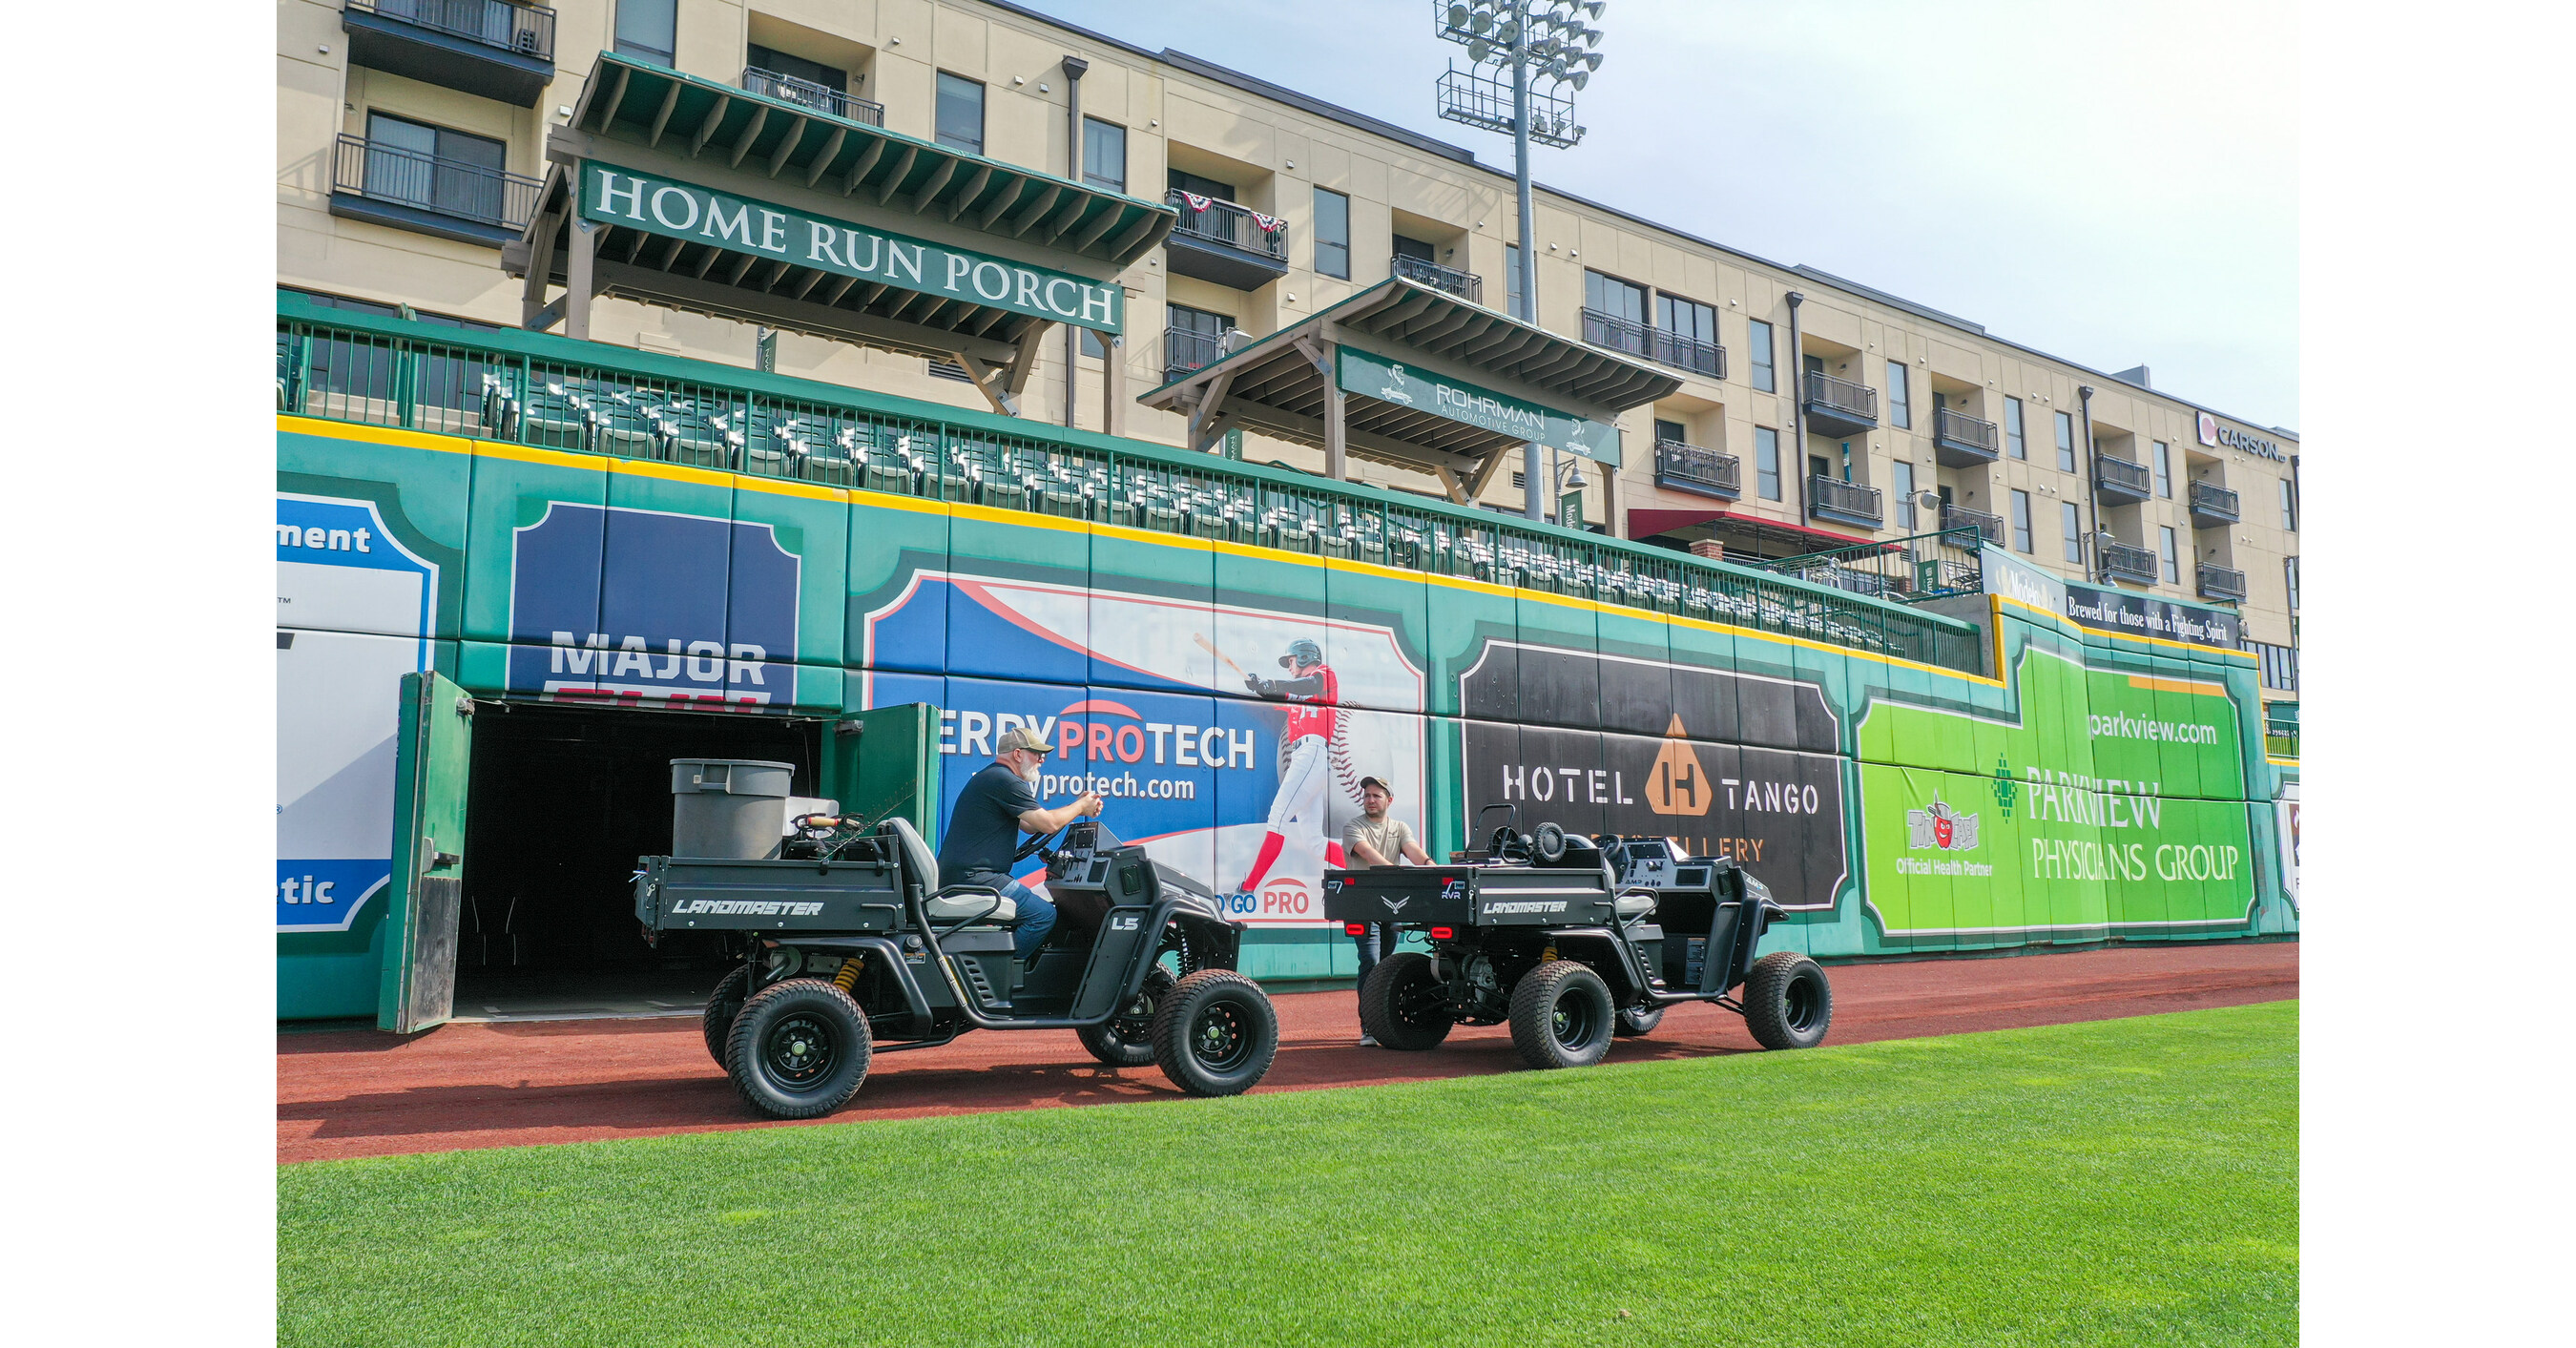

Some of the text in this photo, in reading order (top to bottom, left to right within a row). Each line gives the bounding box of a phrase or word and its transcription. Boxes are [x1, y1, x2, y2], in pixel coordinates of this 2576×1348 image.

[595, 169, 1115, 325] HOME RUN PORCH
[1436, 383, 1545, 430] ROHRMAN
[1441, 404, 1546, 442] AUTOMOTIVE GROUP
[2217, 426, 2278, 462] CARSON
[1566, 504, 1576, 529] Mode
[2067, 595, 2228, 642] Brewed for those with a Fighting Spirit
[551, 631, 766, 686] MAJOR
[940, 709, 1255, 770] ERYPROTECH
[2089, 711, 2217, 745] parkview.com
[1028, 771, 1195, 800] yprotech.com
[1503, 764, 1633, 805] HOTEL
[1721, 778, 1818, 815] TANGO
[2026, 766, 2161, 830] PARKVIEW
[1896, 858, 1992, 877] Official Health Partner
[2032, 838, 2238, 881] PHYSICIANS GROUP
[277, 876, 334, 904] tic
[672, 900, 824, 916] LANDMASTER
[1231, 894, 1257, 914] GO
[1264, 891, 1309, 914] PRO
[1483, 901, 1568, 915] LANDMASTER
[1111, 917, 1139, 931] L5
